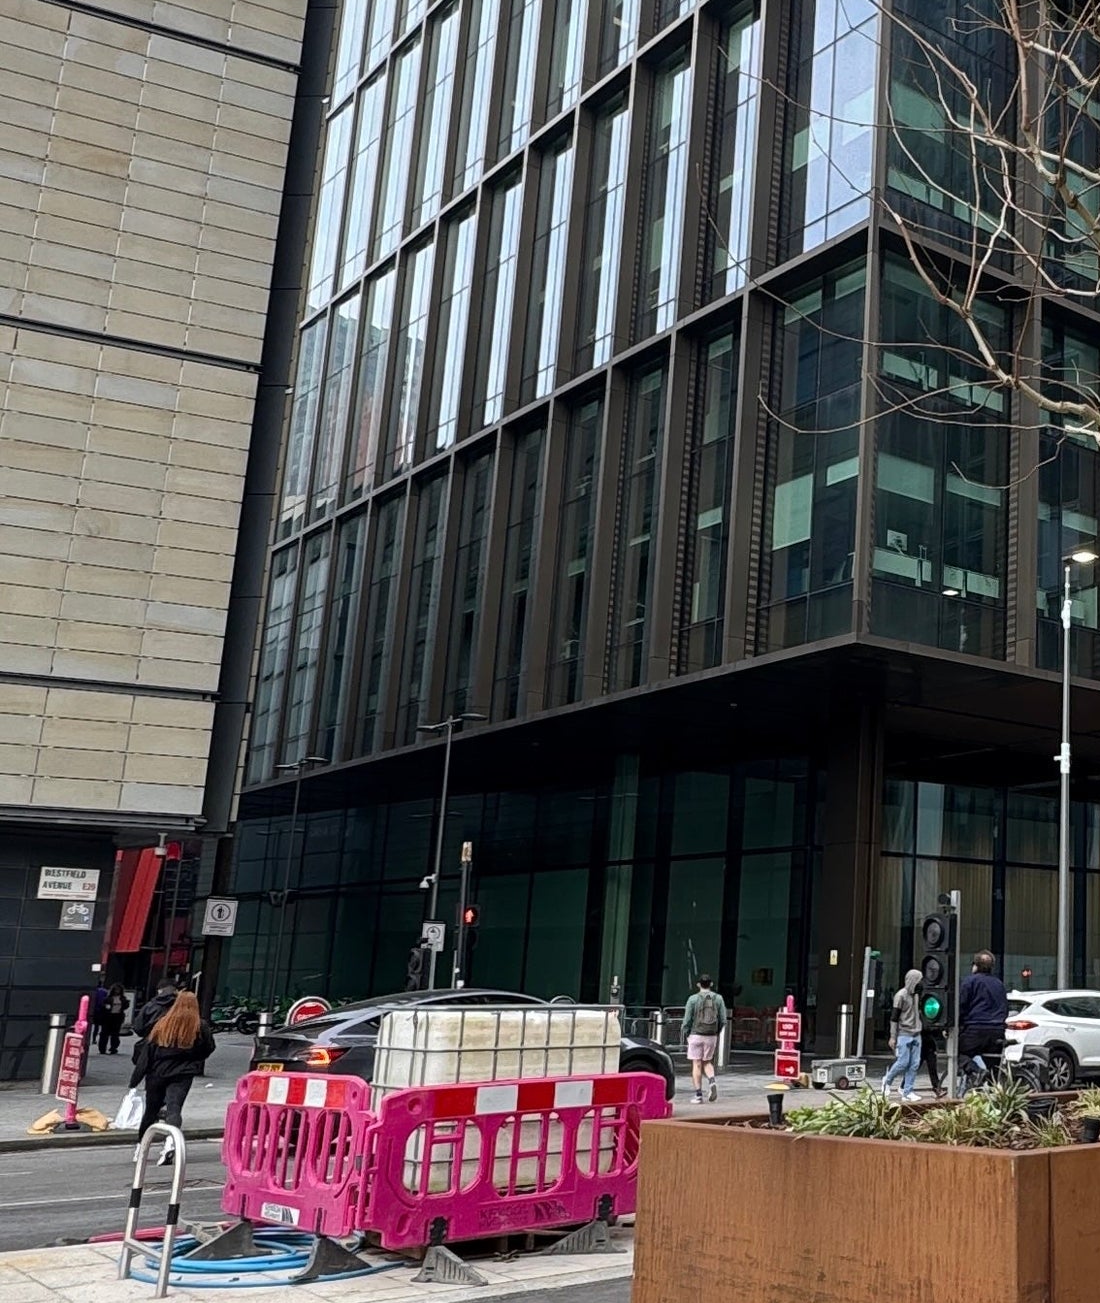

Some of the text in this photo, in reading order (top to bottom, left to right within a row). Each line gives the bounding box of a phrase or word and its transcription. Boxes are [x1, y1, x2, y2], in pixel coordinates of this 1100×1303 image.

[45, 869, 86, 879] WESTFIELD
[42, 881, 96, 891] AVENUE E20
